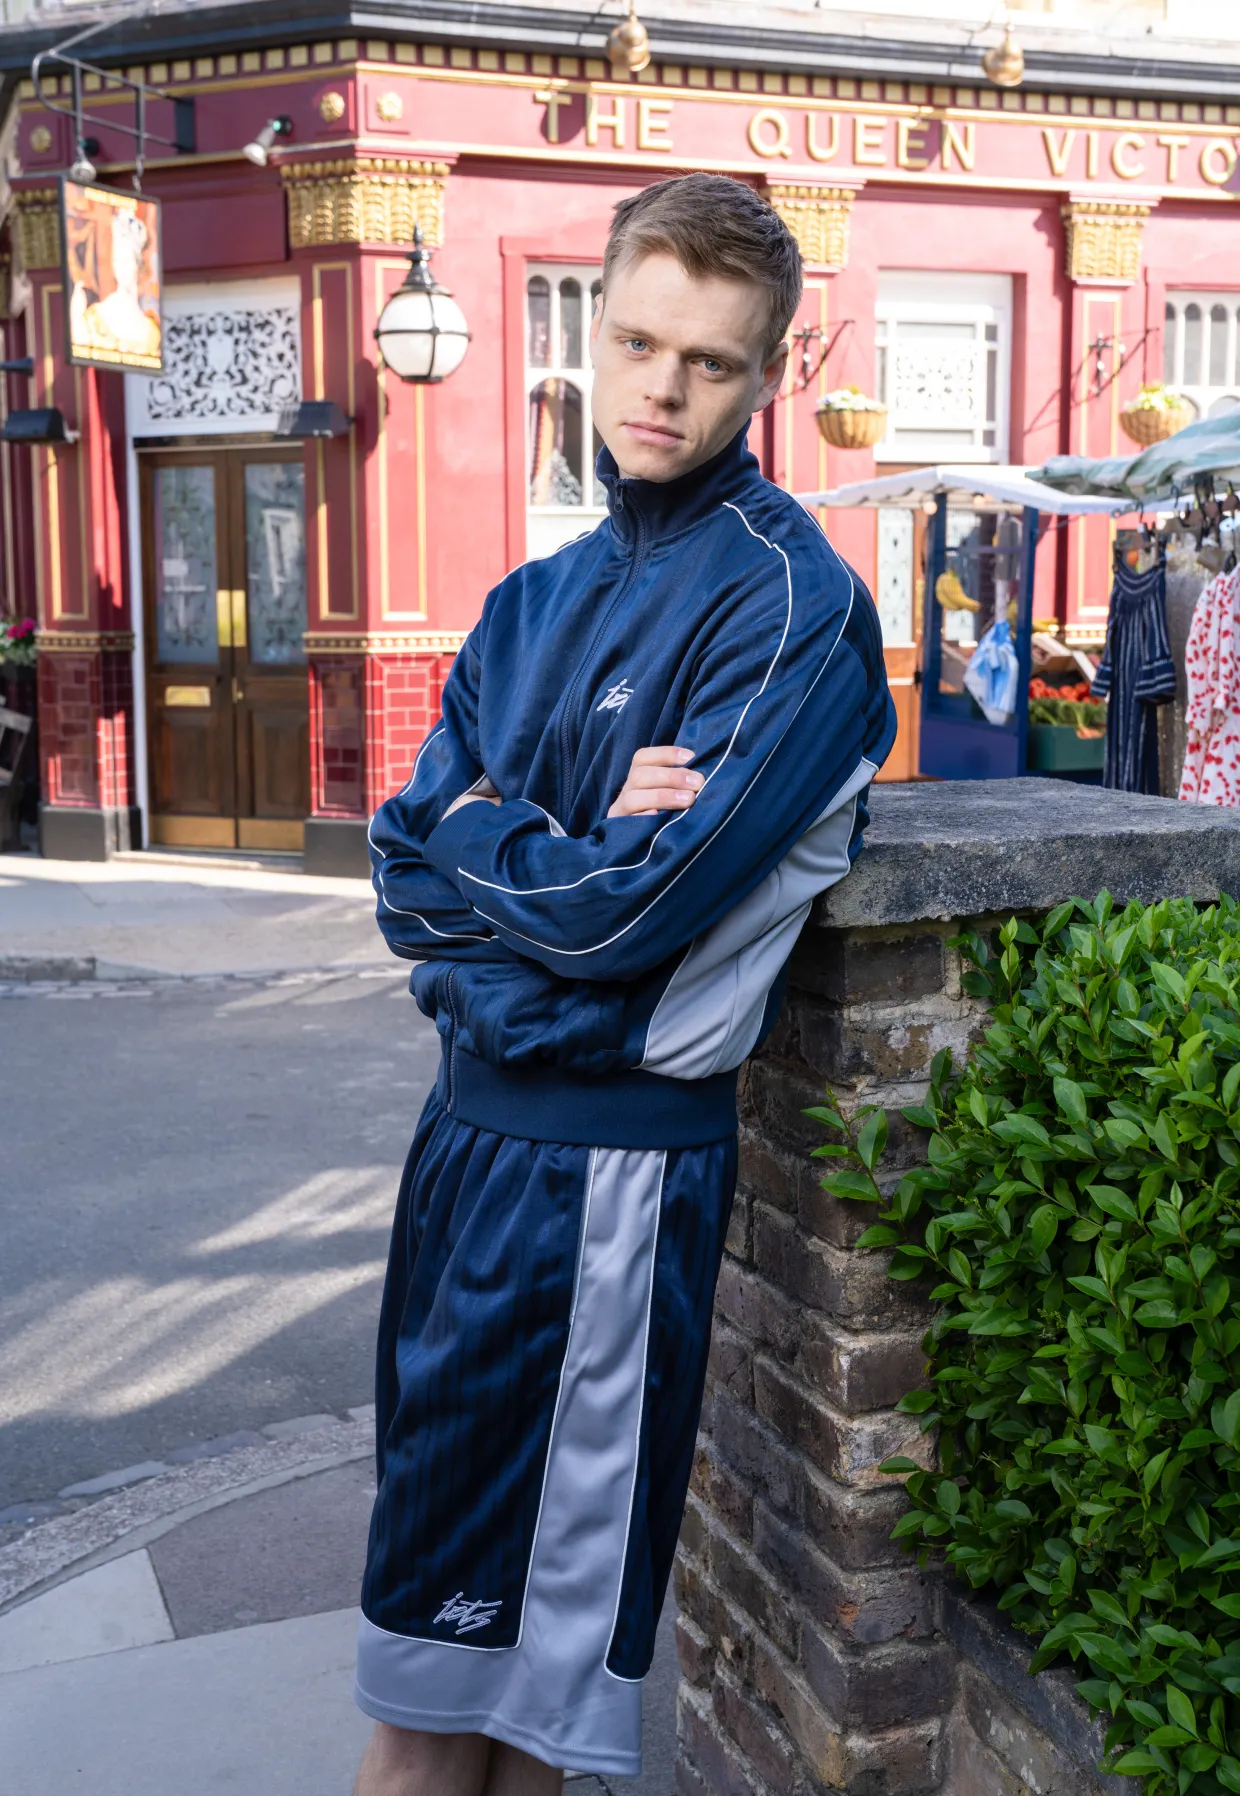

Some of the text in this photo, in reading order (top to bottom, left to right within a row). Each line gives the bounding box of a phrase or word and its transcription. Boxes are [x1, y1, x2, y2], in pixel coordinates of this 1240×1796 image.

[533, 91, 1238, 185] THE QUEEN VICTO
